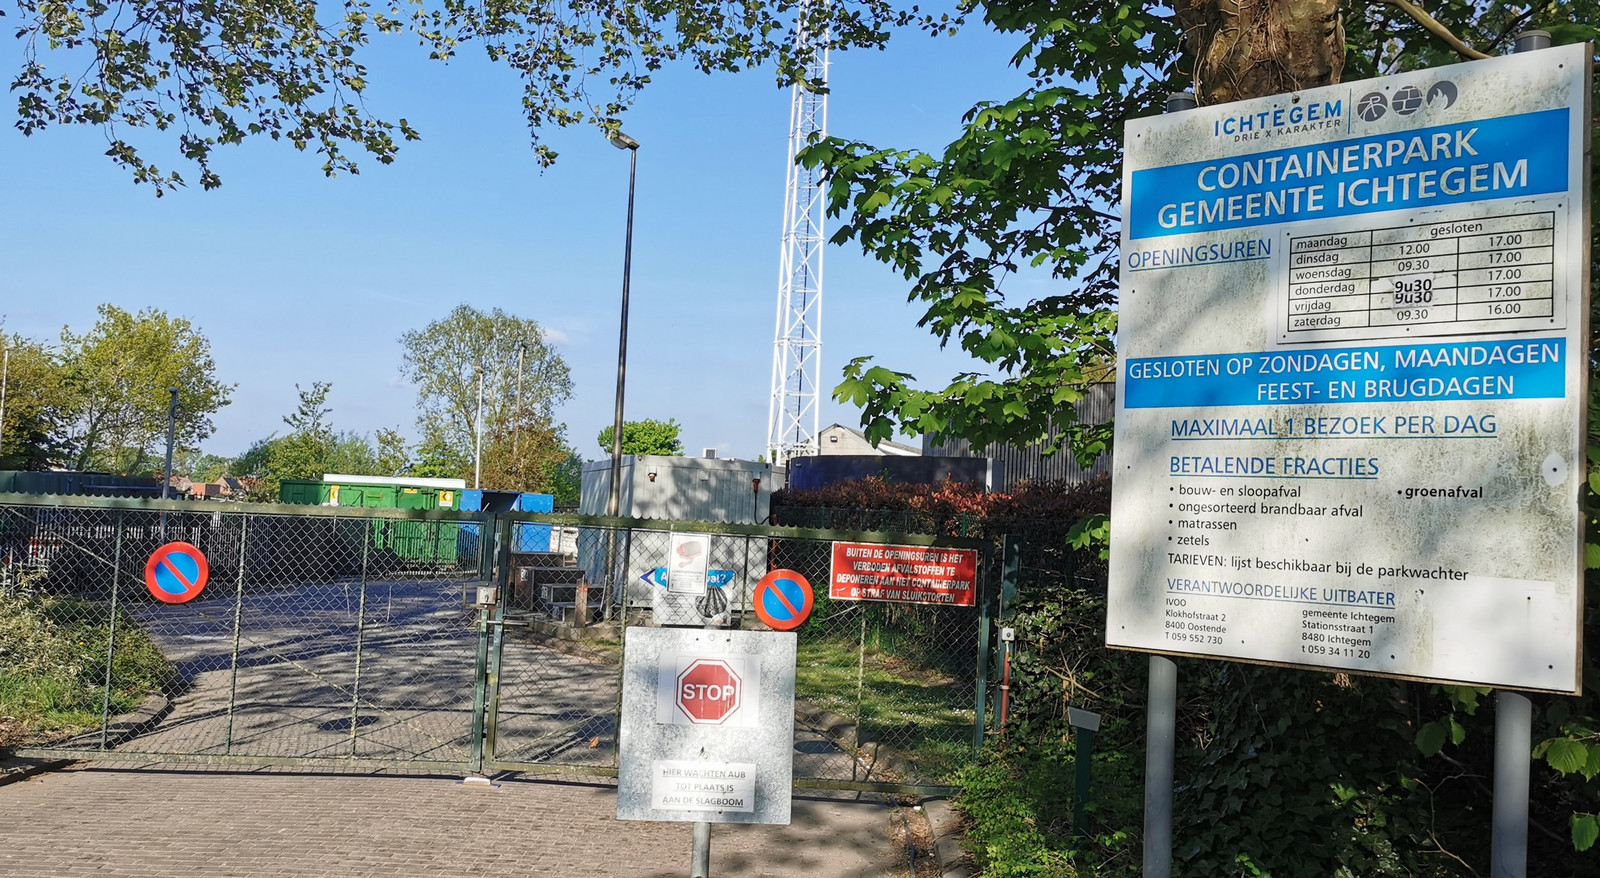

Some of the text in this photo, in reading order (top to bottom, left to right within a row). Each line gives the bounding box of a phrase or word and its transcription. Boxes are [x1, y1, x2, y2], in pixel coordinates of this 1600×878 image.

[1214, 99, 1342, 137] ICHTEGEM
[1234, 118, 1341, 142] DRIE X KARAKTER
[1197, 127, 1479, 192] CONTAINERPARK
[1157, 158, 1528, 229] GEMEENTE ICHTEGEM
[1430, 222, 1483, 238] gesloten
[1296, 236, 1348, 250] maandag
[1488, 234, 1522, 247] 17.00
[1128, 238, 1271, 269] OPENINGSUREN
[1399, 243, 1430, 256] 12.00
[1296, 252, 1339, 265] dinsdag
[1488, 251, 1522, 264] 17.00
[1397, 259, 1430, 272] 09.30
[1295, 267, 1352, 280] woensdag
[1487, 268, 1522, 281] 17.00
[1295, 282, 1355, 296] donderdag
[1395, 278, 1432, 294] 9u30
[1487, 285, 1521, 298] 17.00
[1294, 300, 1332, 312] vrijdag
[1487, 303, 1521, 315] 16.00
[1294, 315, 1341, 328] zaterdag
[1396, 308, 1429, 321] 09.30
[1129, 343, 1559, 379] GESLOTEN OP ZONDAGEN, MAANDAGEN
[1257, 375, 1514, 401] FEEST- EN BRUGDAGEN
[1171, 414, 1497, 437] MAXIMAAL 1 BEZOEK PER DAG
[1170, 456, 1379, 476] BETALENDE FRACTIES
[1179, 484, 1301, 499] bouw- en sloopafval
[1405, 485, 1483, 500] groenafval
[1178, 501, 1363, 518] ongesorteerd brandbaar afval
[1177, 519, 1237, 531] matrassen
[1177, 533, 1210, 547] zetels
[846, 547, 964, 564] BUITEN DE OPENINGSUREN IS HET
[853, 560, 955, 577] VERBODEN AFVALSTOFFEN TE
[1168, 552, 1469, 582] TARIEVEN: lijst beschikbaar bij de parkwachter
[850, 587, 860, 597] OP
[886, 590, 901, 600] VAN
[902, 591, 955, 603] SLUIKSTORTEN
[1167, 578, 1395, 606] VERANTWOORDELIJKE UITBATER
[1165, 597, 1187, 607] IVOO
[1165, 609, 1217, 622] Klokhofstraat
[1302, 608, 1395, 624] gemeente Ichtegem
[1165, 620, 1227, 634] 8400 Oostende
[1302, 620, 1366, 633] Stationsstraat
[1171, 632, 1187, 642] 059
[1189, 634, 1204, 643] 552
[1207, 635, 1223, 645] 730
[1302, 632, 1372, 647] 8480 Ichtegem
[1308, 645, 1326, 655] 059
[1328, 646, 1340, 656] 34
[1344, 648, 1354, 658] 11
[1358, 650, 1371, 659] 20
[682, 683, 735, 701] STOP
[662, 768, 682, 777] HIER
[728, 770, 746, 779] AUB
[675, 782, 734, 792] TOT PLAATS IS
[662, 796, 681, 804] AAN
[695, 797, 744, 806] SLAGBOOM
